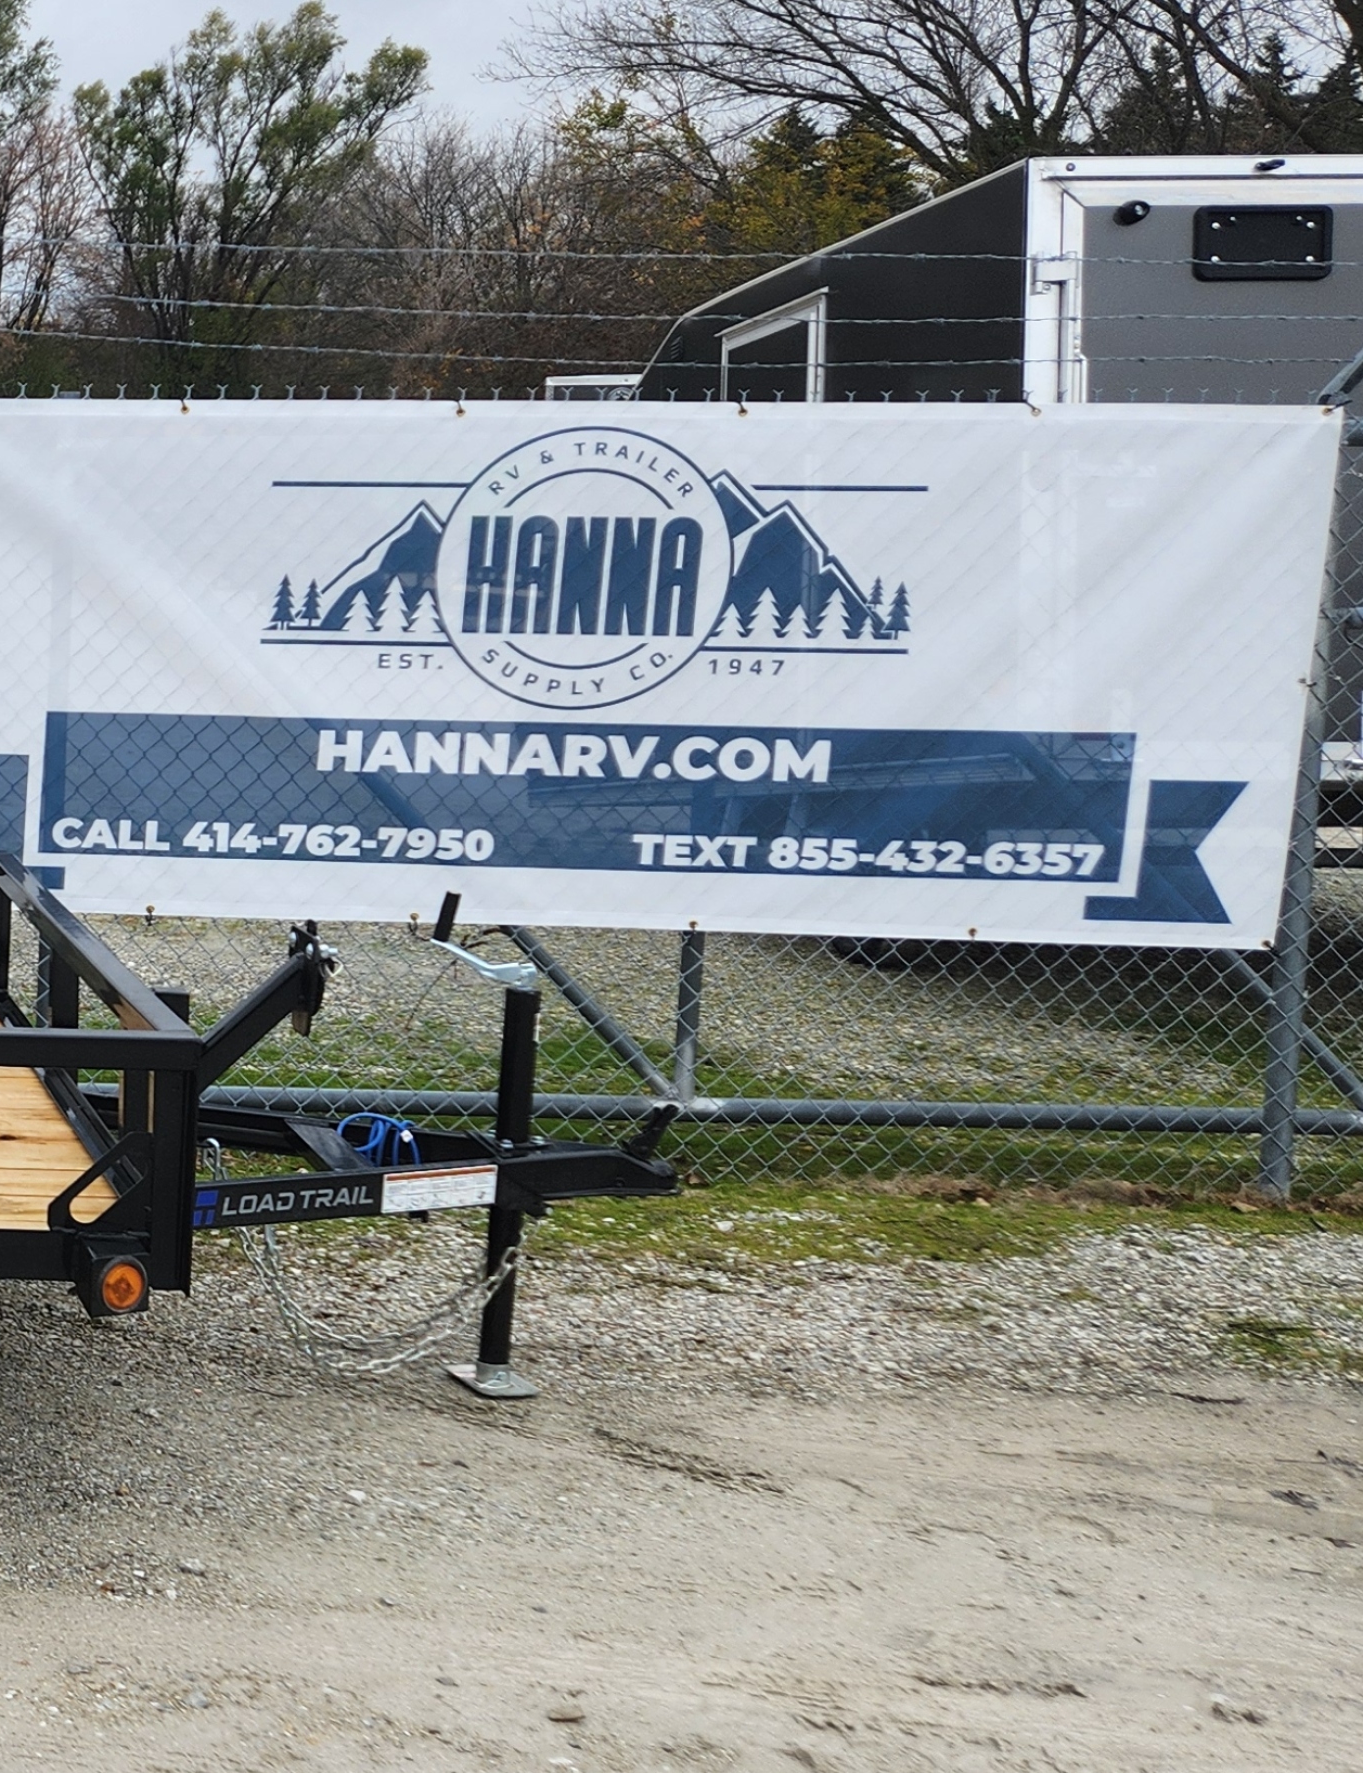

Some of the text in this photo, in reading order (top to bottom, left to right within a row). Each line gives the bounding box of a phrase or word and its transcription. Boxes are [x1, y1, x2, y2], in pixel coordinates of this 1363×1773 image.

[488, 441, 695, 499] RV & TRAILER
[462, 514, 704, 637] HANNA
[377, 653, 443, 670] EST.
[481, 648, 675, 695] SUPPLY CO.
[708, 659, 786, 676] 1947
[316, 729, 833, 784] HANNARV.COM
[52, 817, 495, 862] CALL 414-762-7950
[632, 833, 1106, 877] TEXT 855-432-6357
[221, 1191, 295, 1216] LOAD
[300, 1185, 374, 1209] TRAIL
